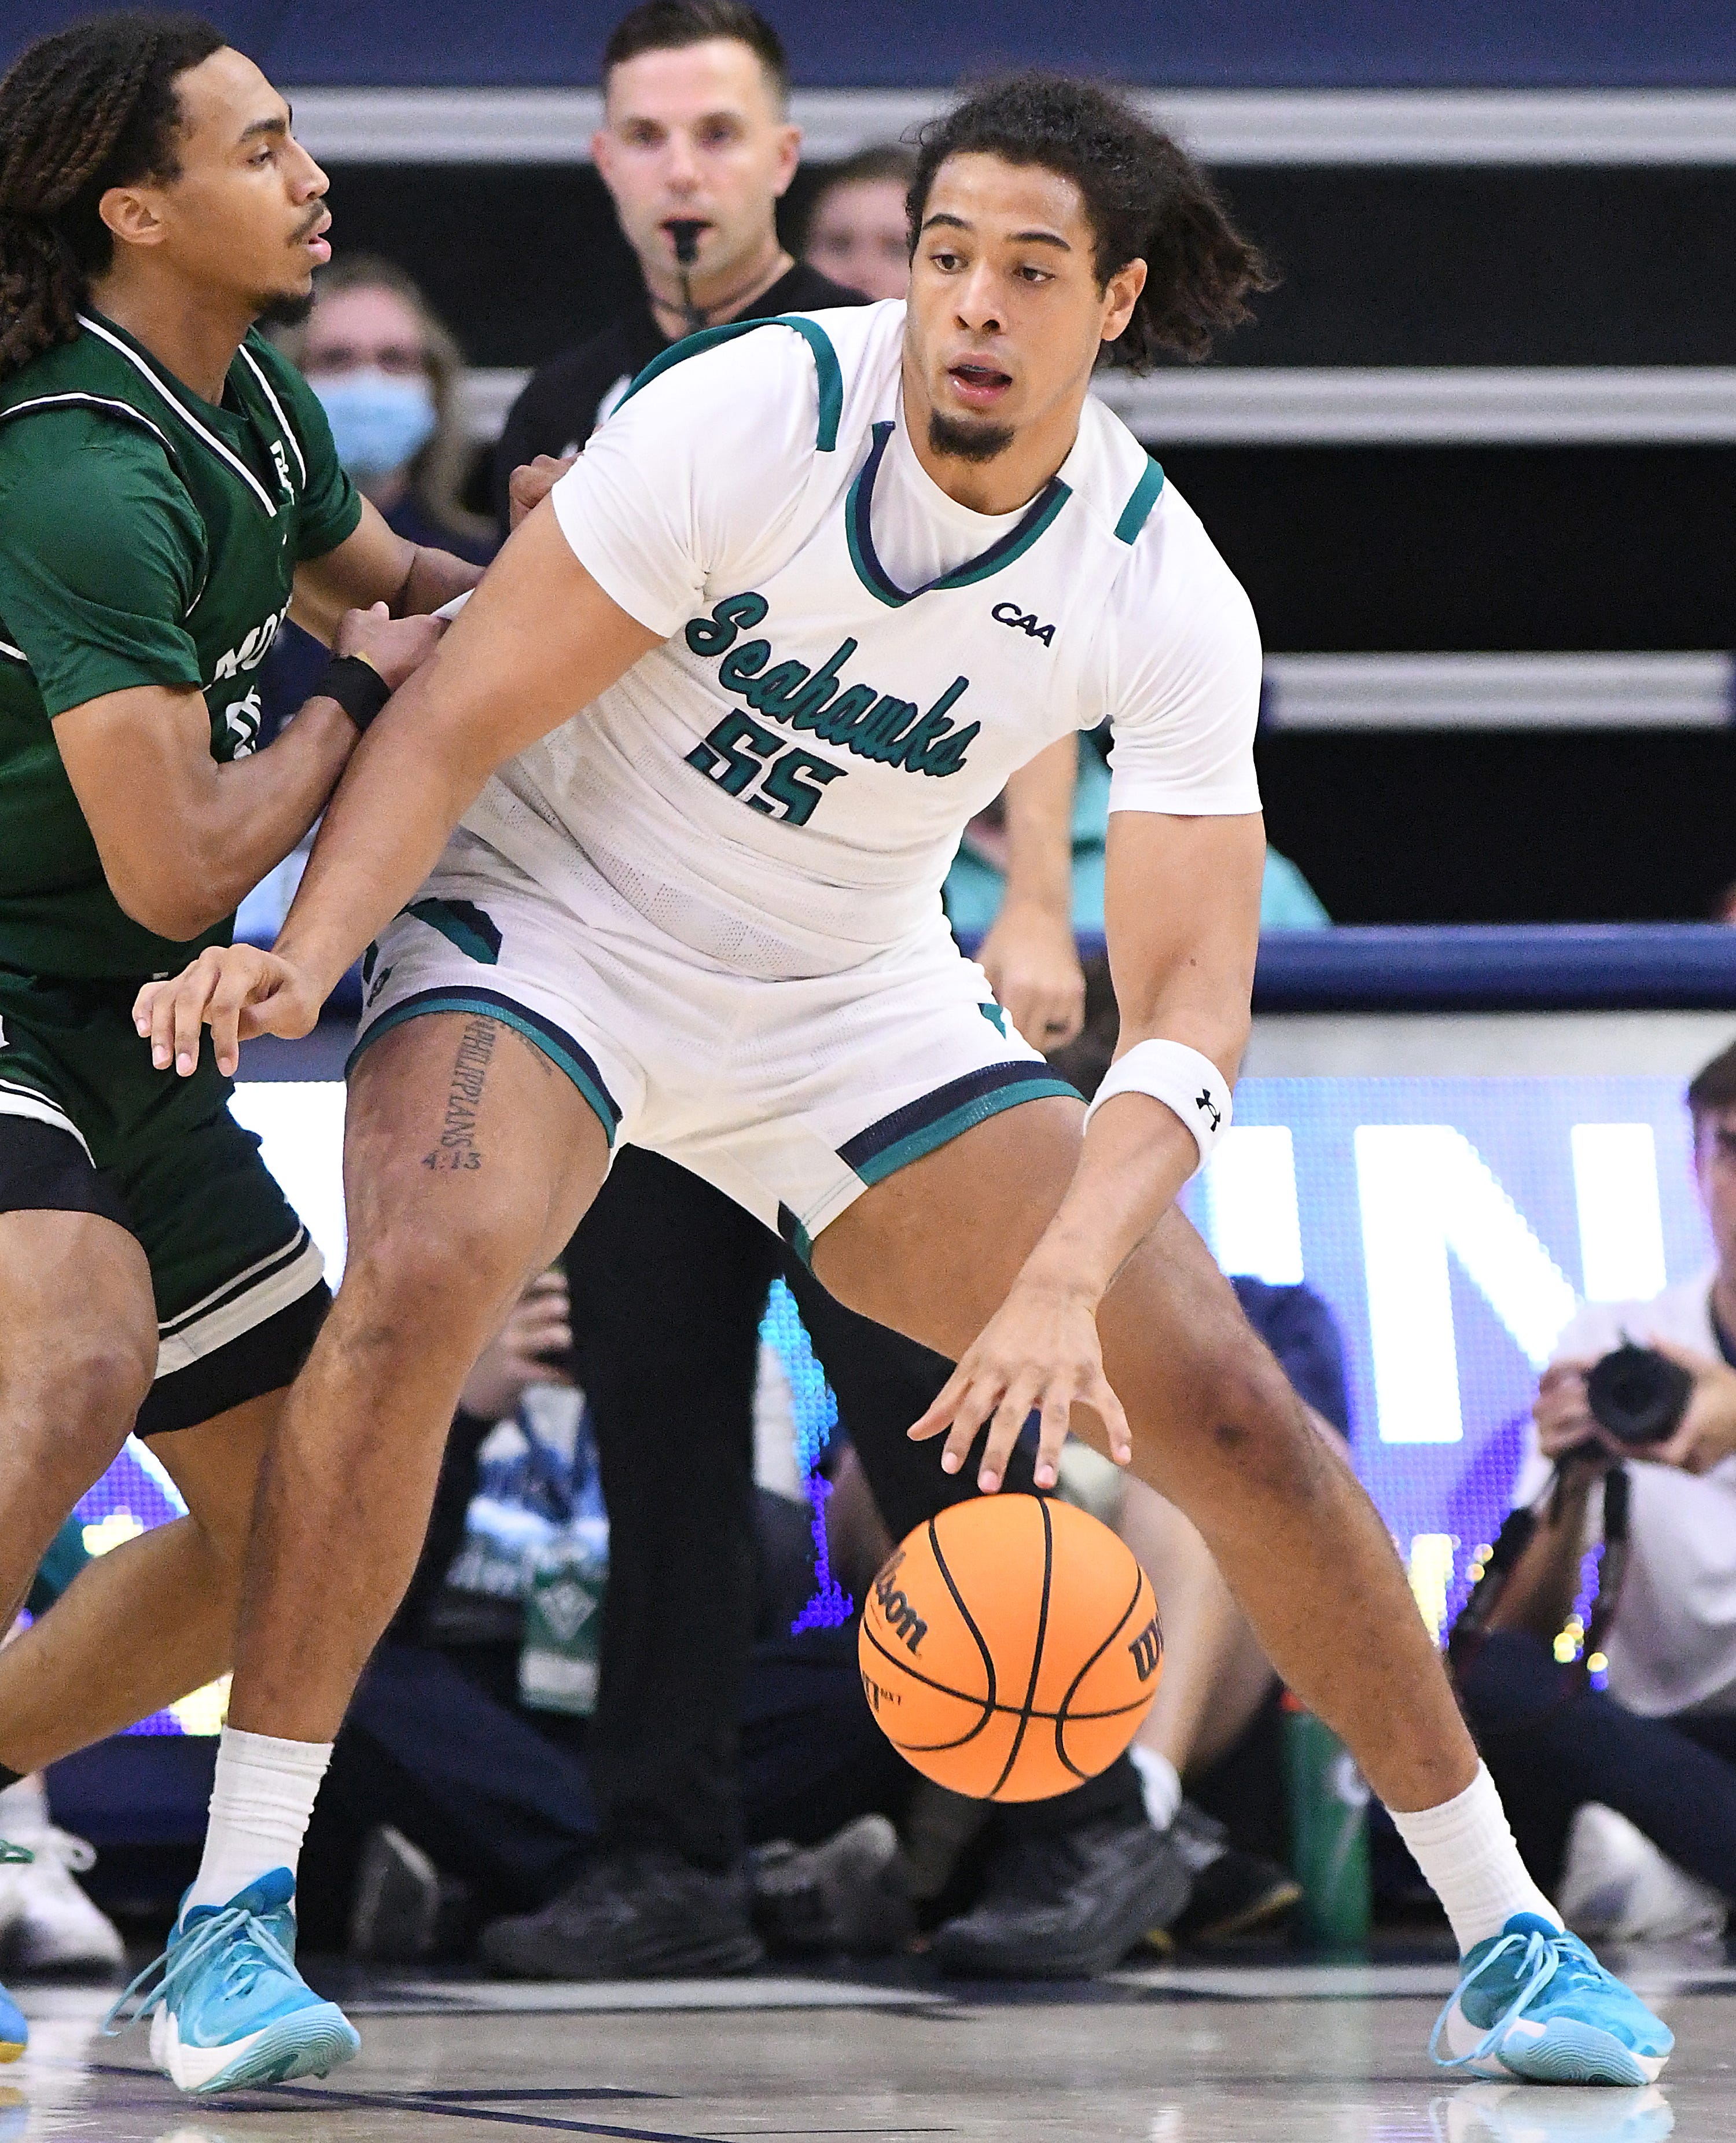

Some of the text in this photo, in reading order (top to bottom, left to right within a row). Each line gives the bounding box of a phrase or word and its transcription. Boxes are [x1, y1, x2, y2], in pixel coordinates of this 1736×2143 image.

[685, 591, 981, 777] Seahawks
[991, 602, 1057, 648] CAA
[684, 708, 848, 826] 55
